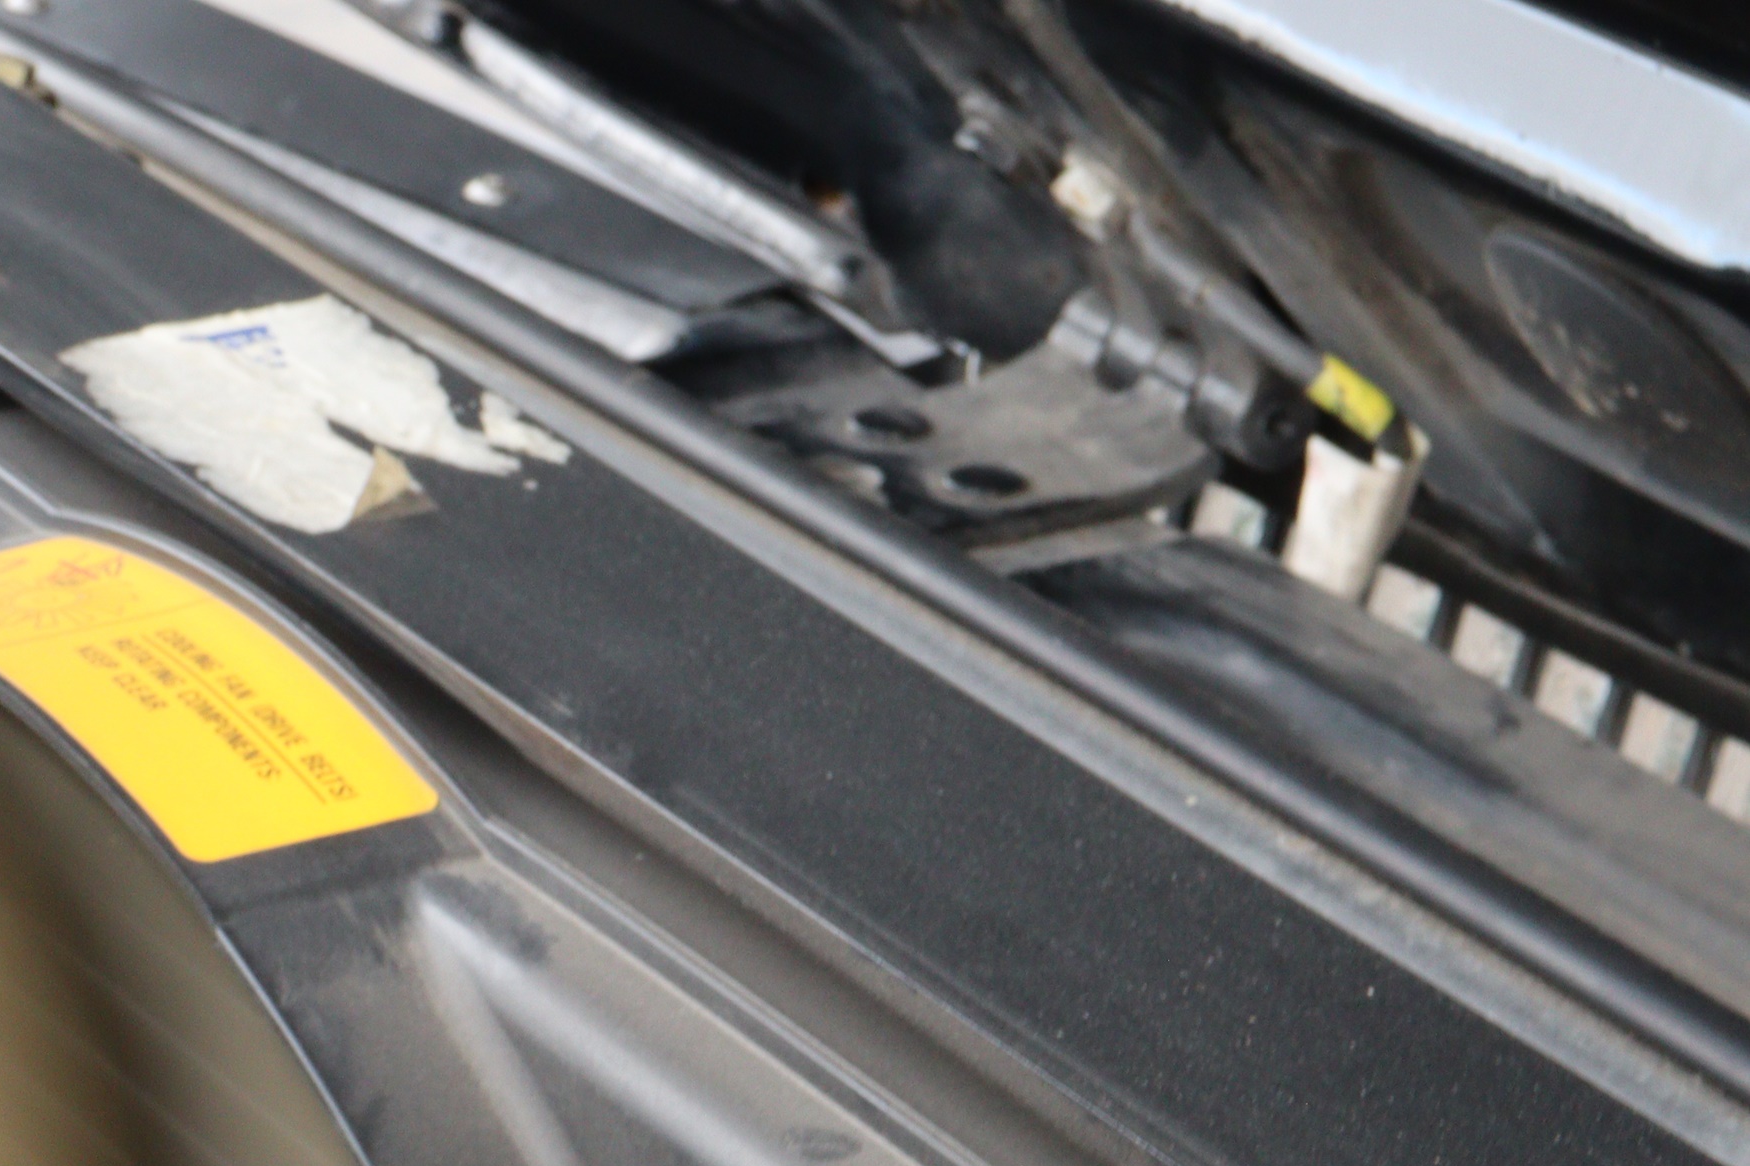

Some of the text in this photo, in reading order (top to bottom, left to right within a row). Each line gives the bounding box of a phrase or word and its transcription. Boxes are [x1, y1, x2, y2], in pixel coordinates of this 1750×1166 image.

[113, 671, 169, 713] CLEAR
[221, 673, 254, 700] FAN
[177, 688, 281, 781] COMPONENTS
